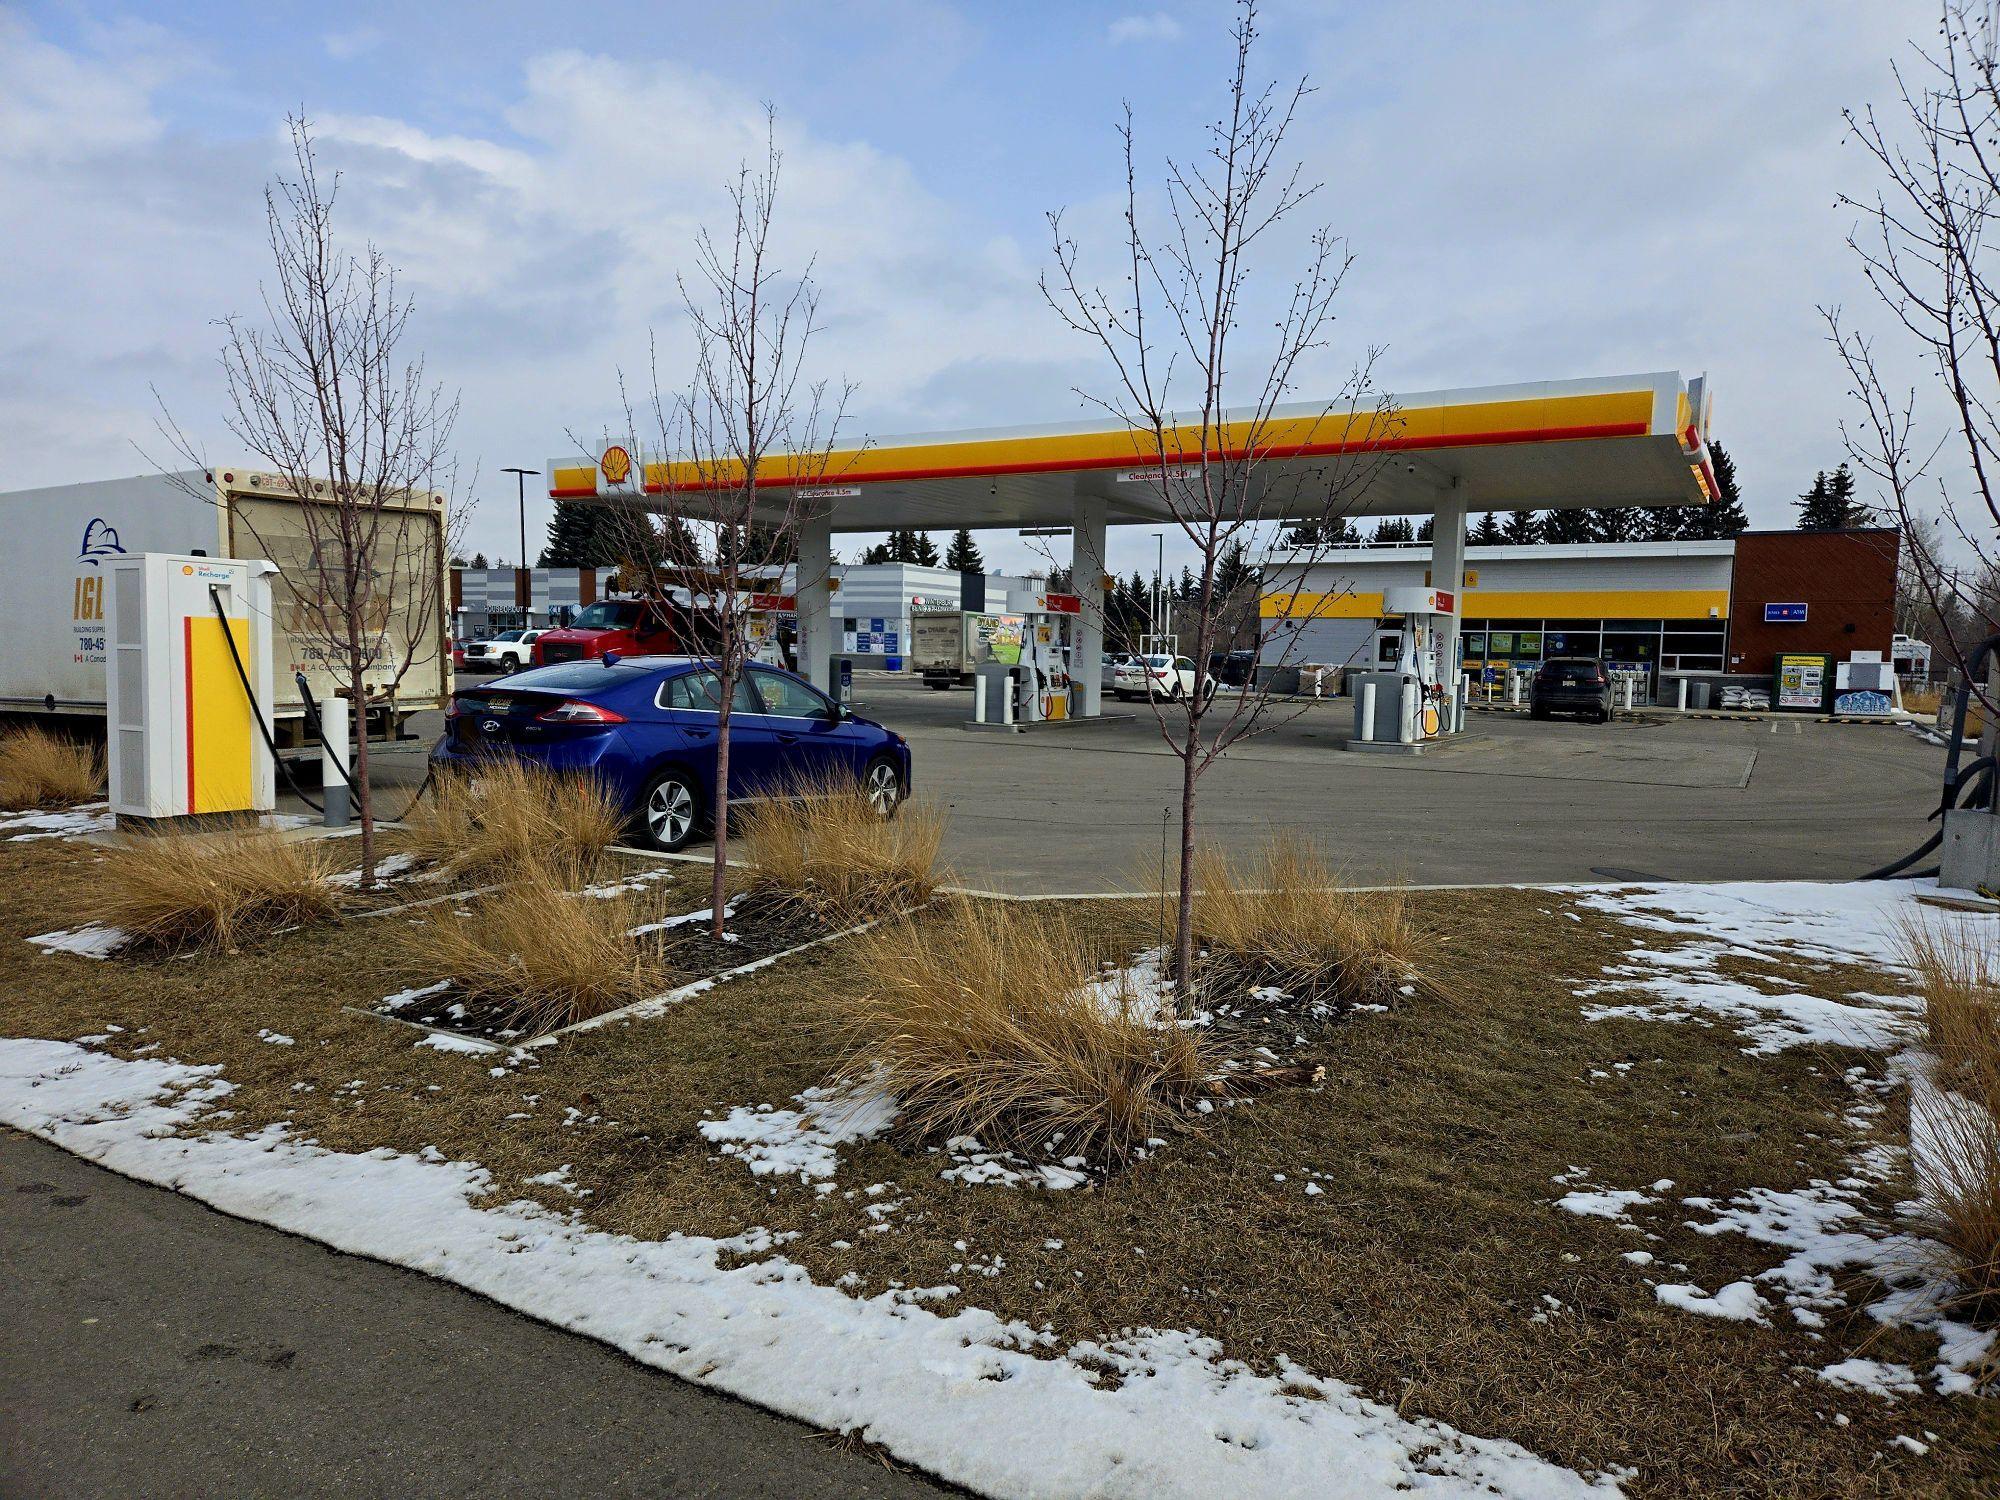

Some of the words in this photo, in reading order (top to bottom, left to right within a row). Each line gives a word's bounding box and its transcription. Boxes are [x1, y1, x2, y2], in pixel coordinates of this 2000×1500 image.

[1129, 471, 1166, 480] Clearanc
[198, 570, 230, 579] Recharge
[80, 638, 106, 651] 780-45
[361, 663, 396, 673] Cmpany
[1841, 704, 1886, 712] GLACIER
